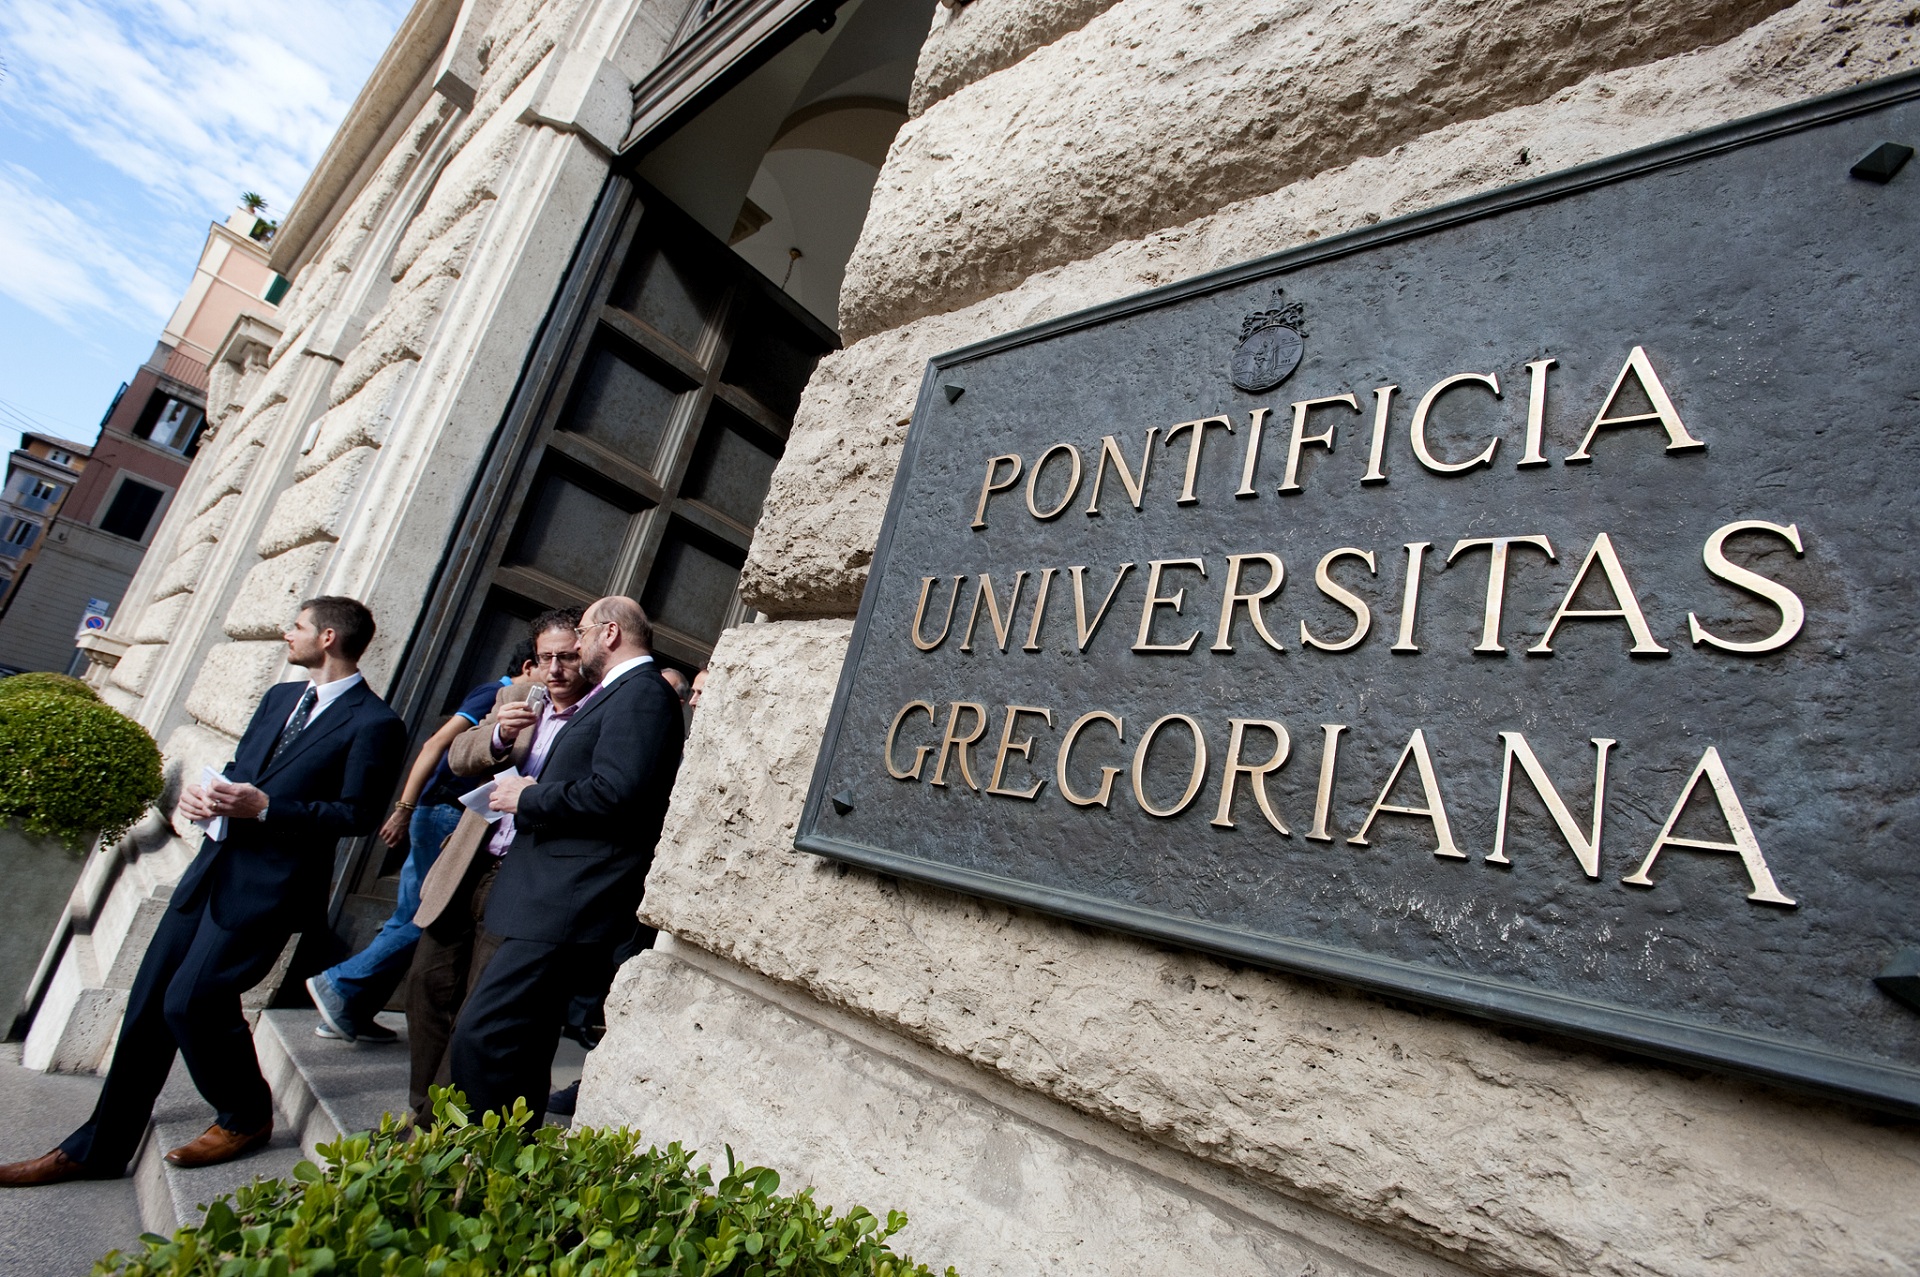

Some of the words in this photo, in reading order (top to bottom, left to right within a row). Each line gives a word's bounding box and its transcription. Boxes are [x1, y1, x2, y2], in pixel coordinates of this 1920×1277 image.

[970, 345, 1705, 530] PONTIFICIA
[911, 519, 1806, 657] UNIVERSITAS
[884, 699, 1797, 906] GREGORIANA
